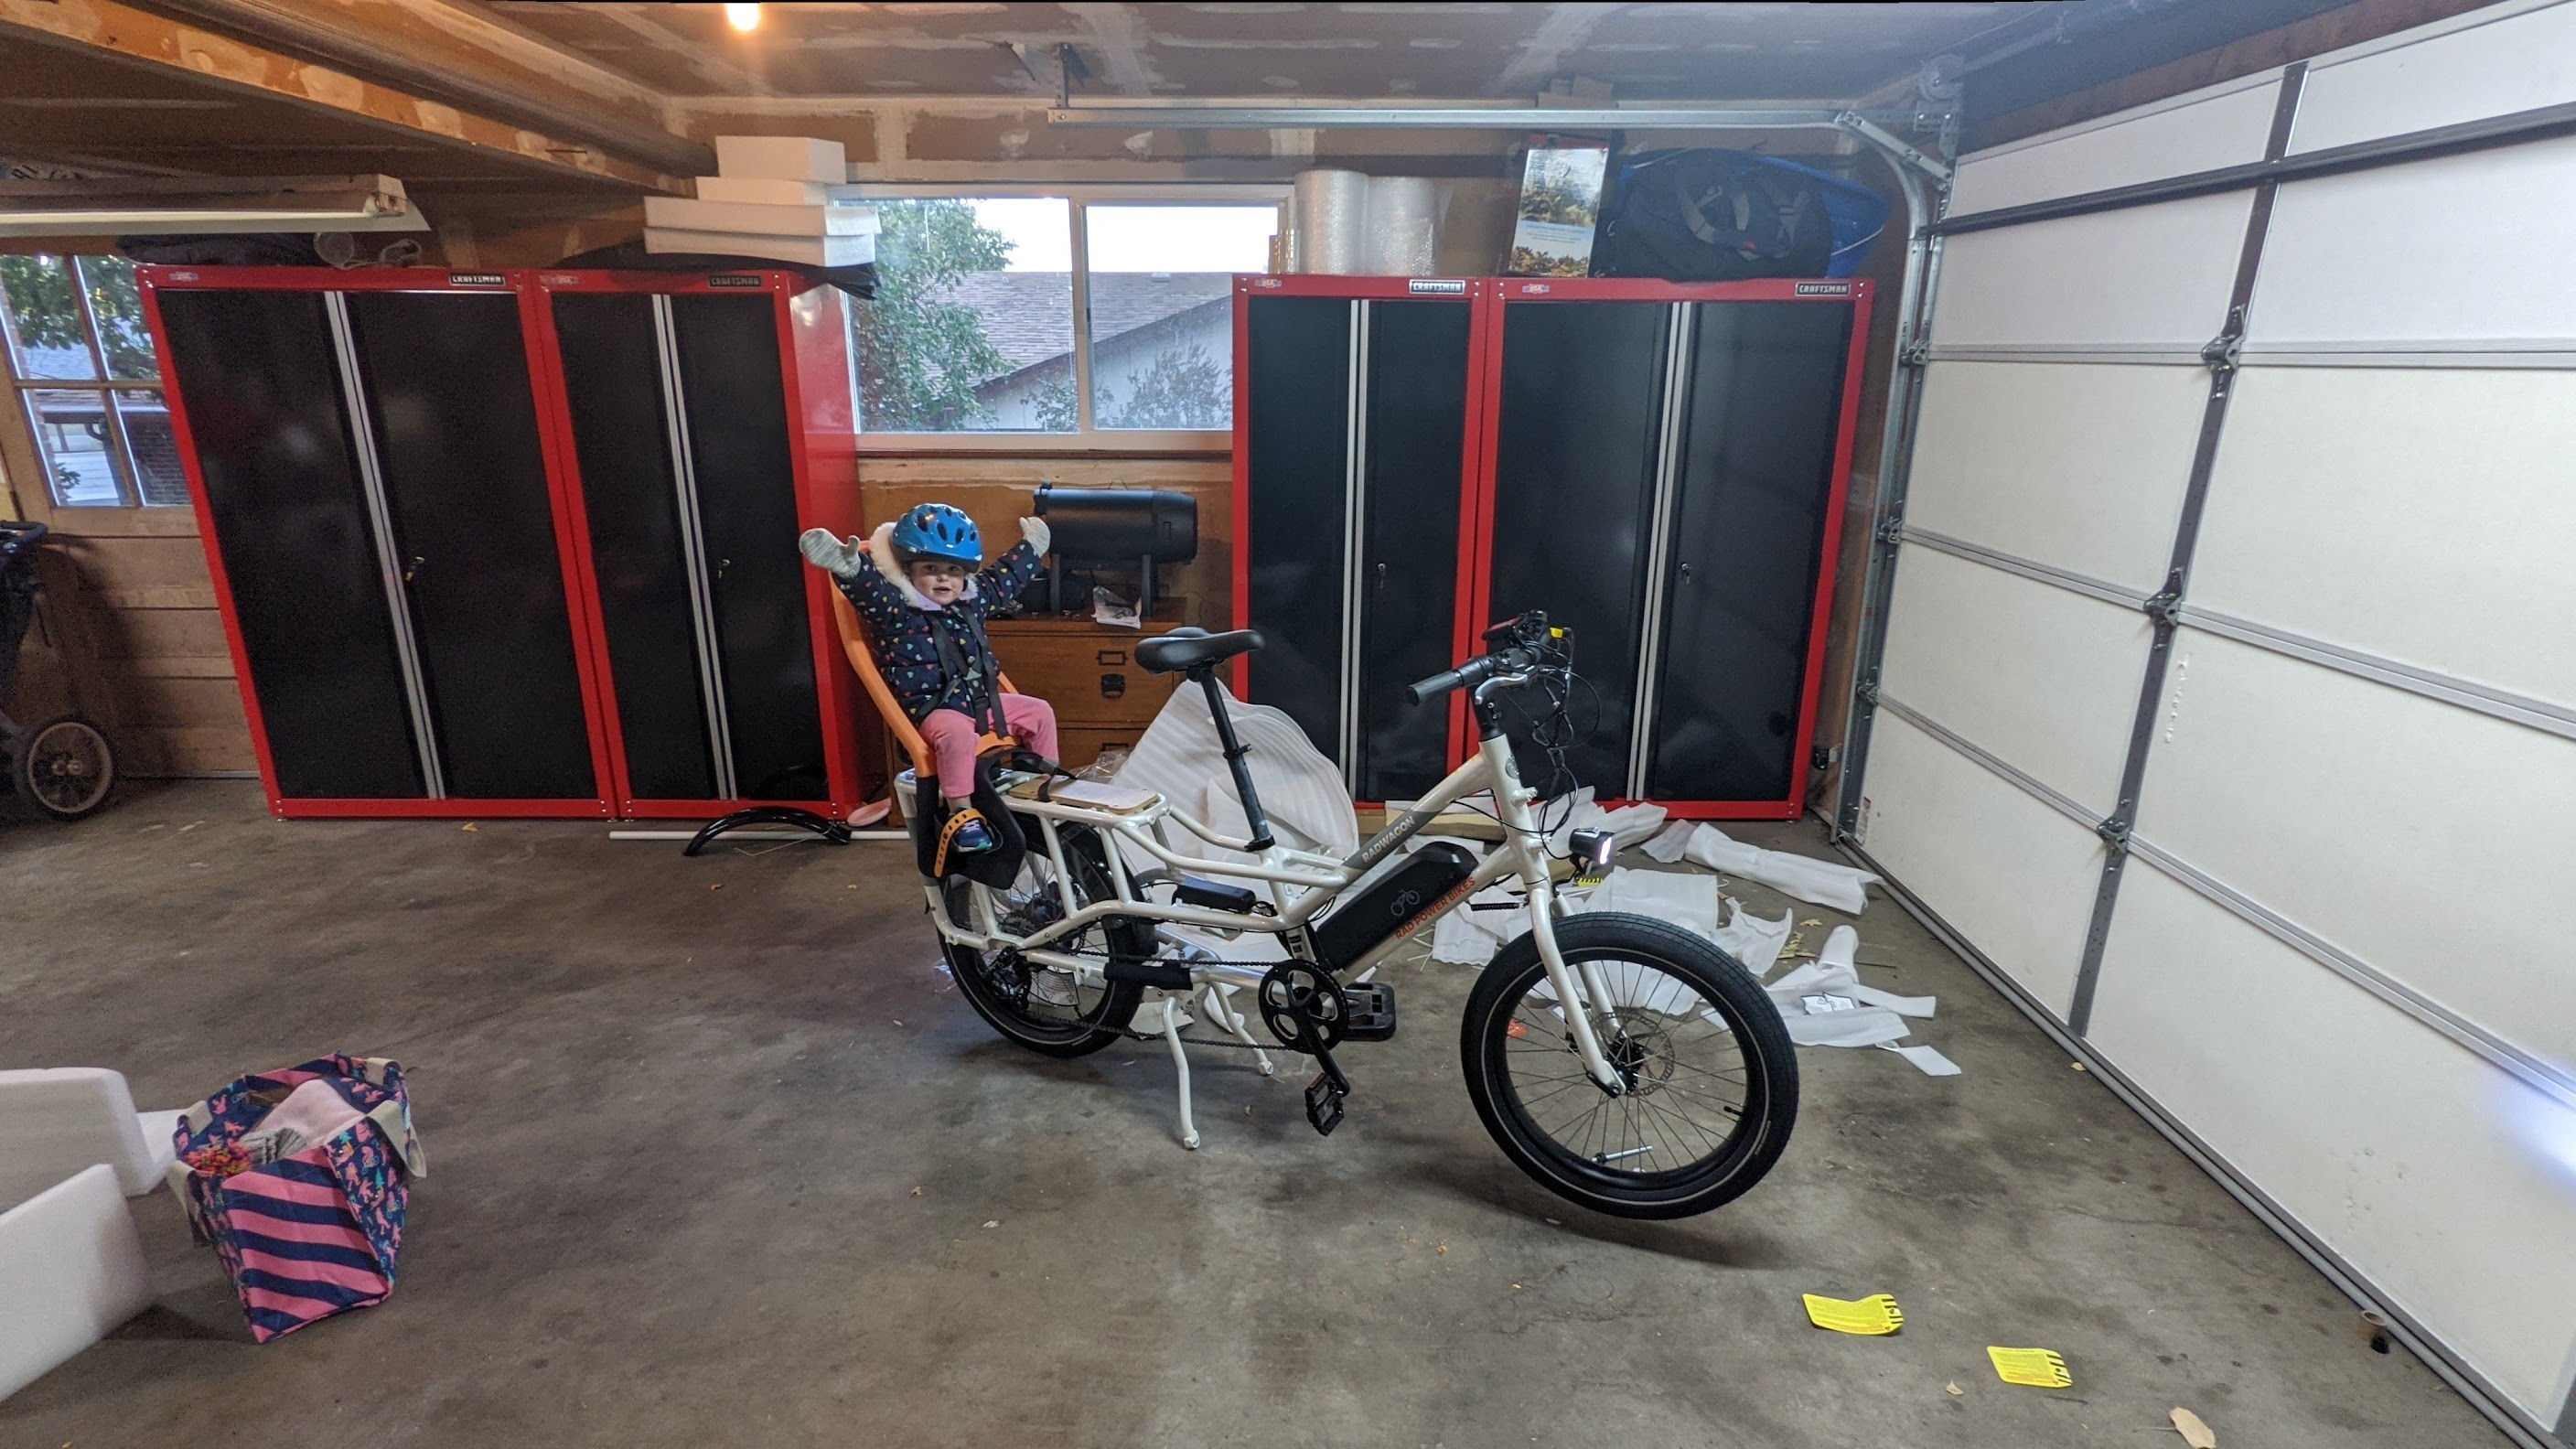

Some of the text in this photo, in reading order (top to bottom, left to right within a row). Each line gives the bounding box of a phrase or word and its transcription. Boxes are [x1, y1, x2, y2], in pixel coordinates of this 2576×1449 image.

[711, 276, 760, 285] CRAFTSMAN
[1412, 282, 1462, 292] CRAFTSMAN
[1798, 284, 1847, 293] CRAFTSMAN
[1362, 815, 1415, 863] RADWAGON
[1395, 876, 1476, 939] RAD POWER BIKES
